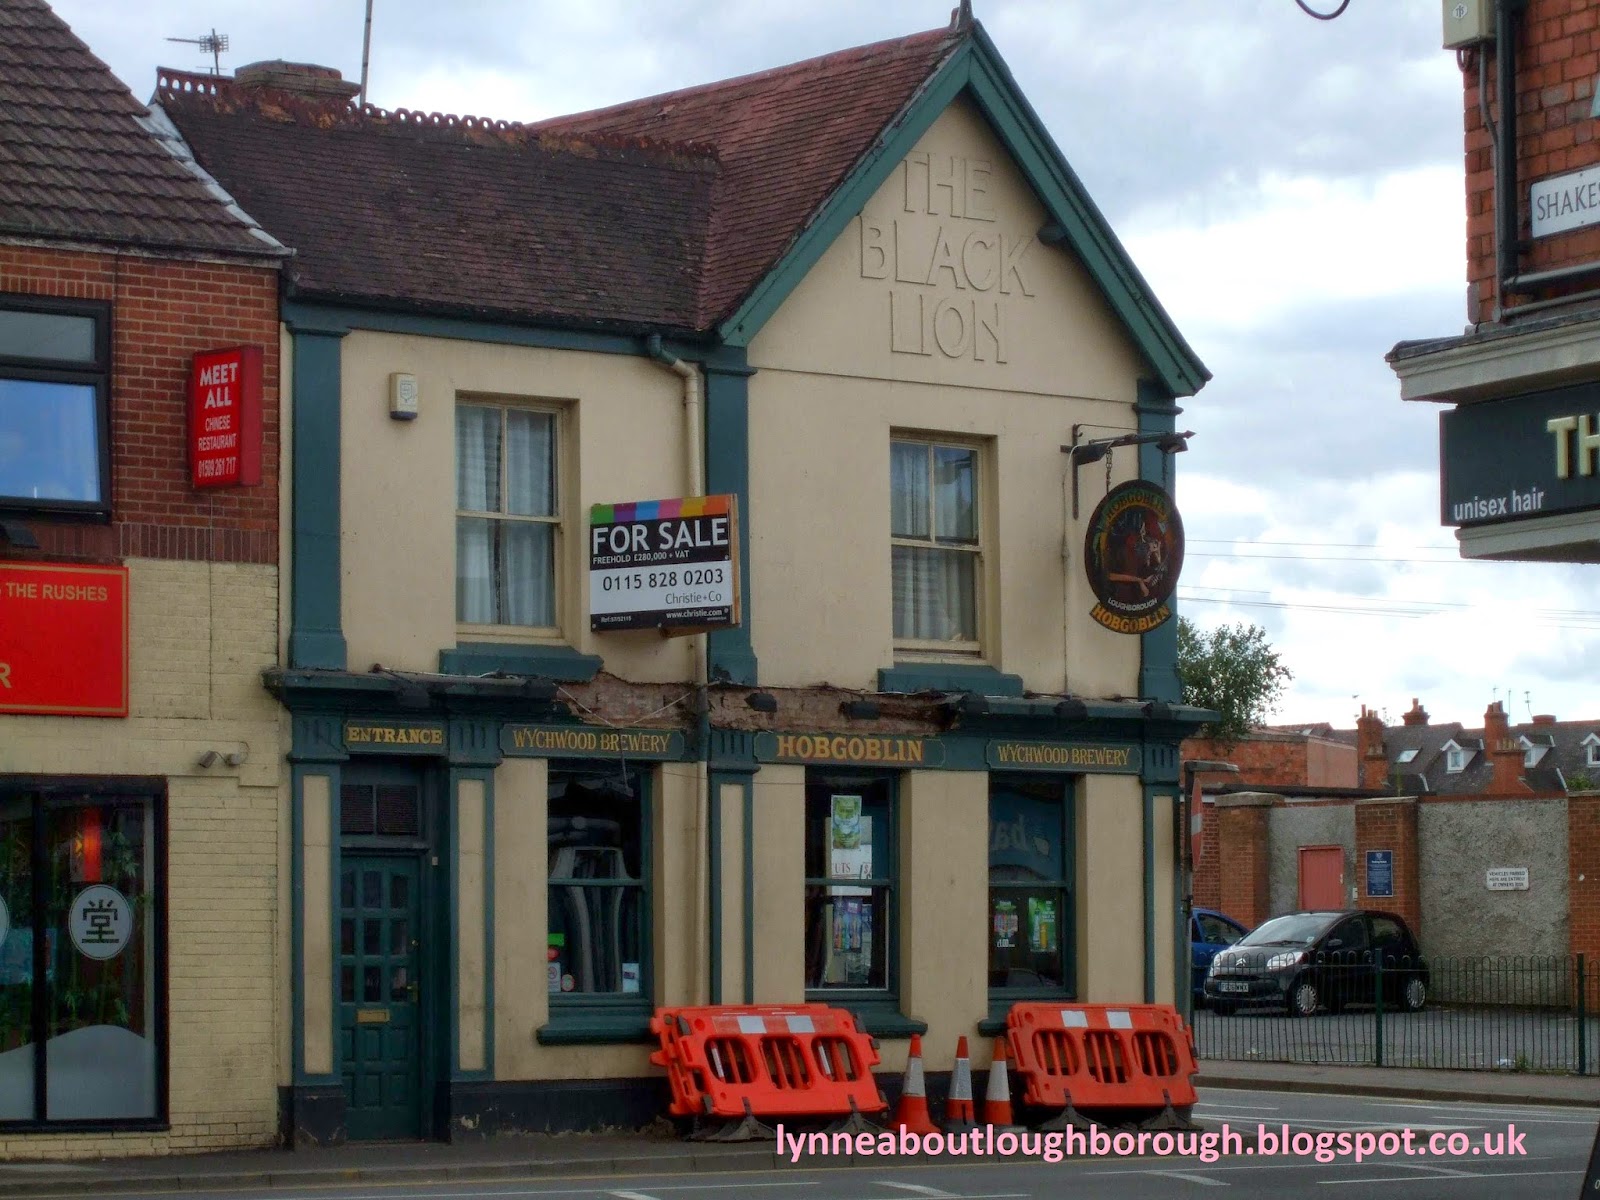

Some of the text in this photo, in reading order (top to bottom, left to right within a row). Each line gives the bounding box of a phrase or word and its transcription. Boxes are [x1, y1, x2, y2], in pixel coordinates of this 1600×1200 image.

[902, 151, 997, 222] THE
[1537, 182, 1600, 220] SHAKE
[858, 214, 1036, 297] BLACK
[888, 290, 1007, 364] LION
[199, 362, 238, 387] MEET
[204, 386, 232, 409] ALL
[204, 414, 231, 432] CHINESE
[198, 433, 237, 451] RESTAURANT
[1547, 412, 1600, 480] TH
[1454, 487, 1545, 521] unisex hair
[593, 517, 729, 555] FOR SALE
[592, 555, 632, 565] FREEHOLD
[633, 551, 667, 562] £280,000
[675, 549, 690, 559] VAT
[6, 582, 108, 601] THE RUSHES
[602, 568, 724, 591] 0115 828 0203
[666, 609, 722, 619] www.christie.com
[1107, 597, 1158, 612] LOUGHBOROUGH
[1092, 603, 1169, 632] HOBGOBLIN
[348, 726, 443, 745] ENTRANCE
[513, 730, 672, 753] WYCHWOOD BREWERY
[776, 734, 925, 762] HOBGOBLIN
[997, 743, 1131, 767] WYCHWOOD BREWERY
